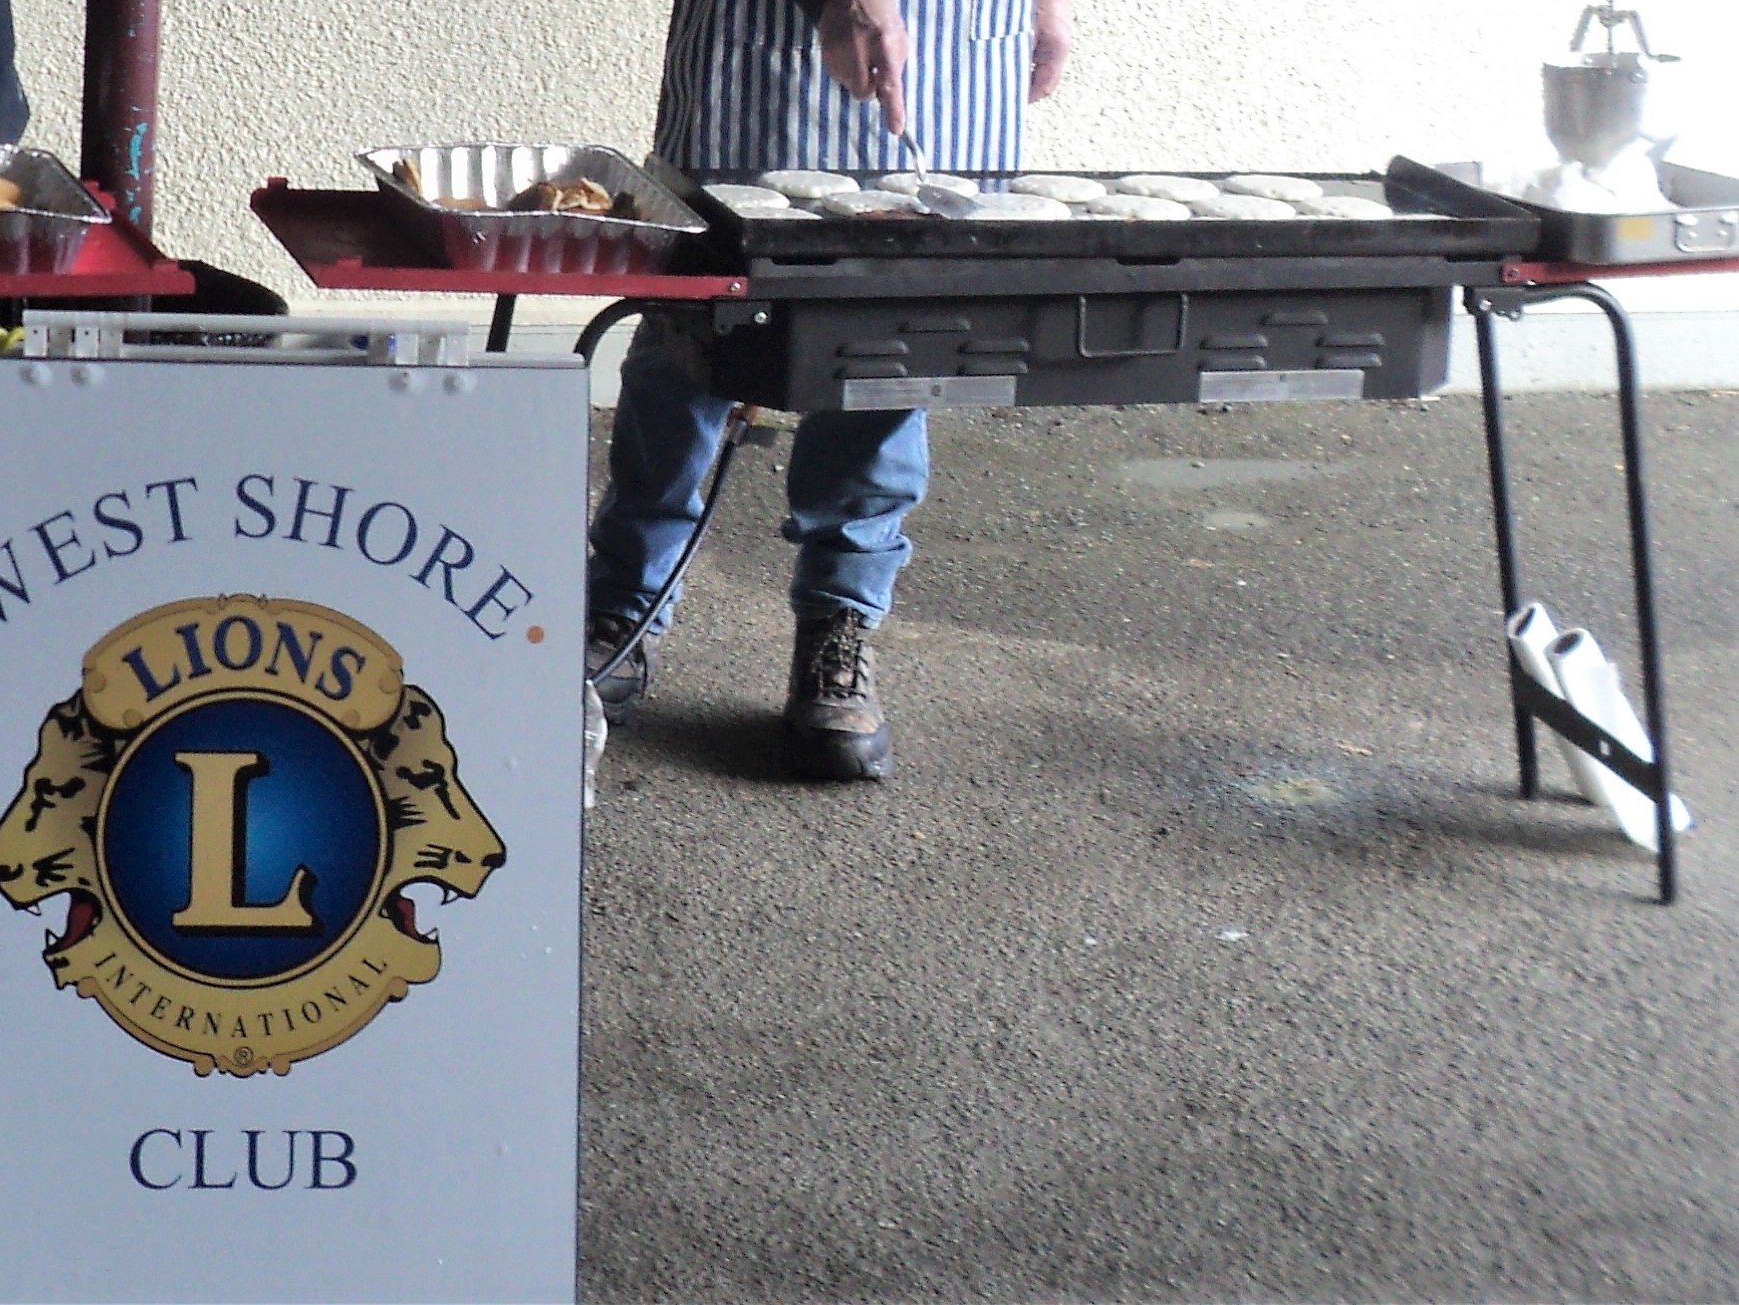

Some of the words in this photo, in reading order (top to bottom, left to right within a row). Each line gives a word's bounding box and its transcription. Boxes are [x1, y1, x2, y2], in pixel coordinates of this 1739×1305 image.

[233, 473, 534, 640] SHORE
[122, 615, 365, 703] LIONS
[172, 751, 317, 931] L
[94, 952, 388, 1038] INTERNATIONAL
[129, 1128, 358, 1190] CLUB
